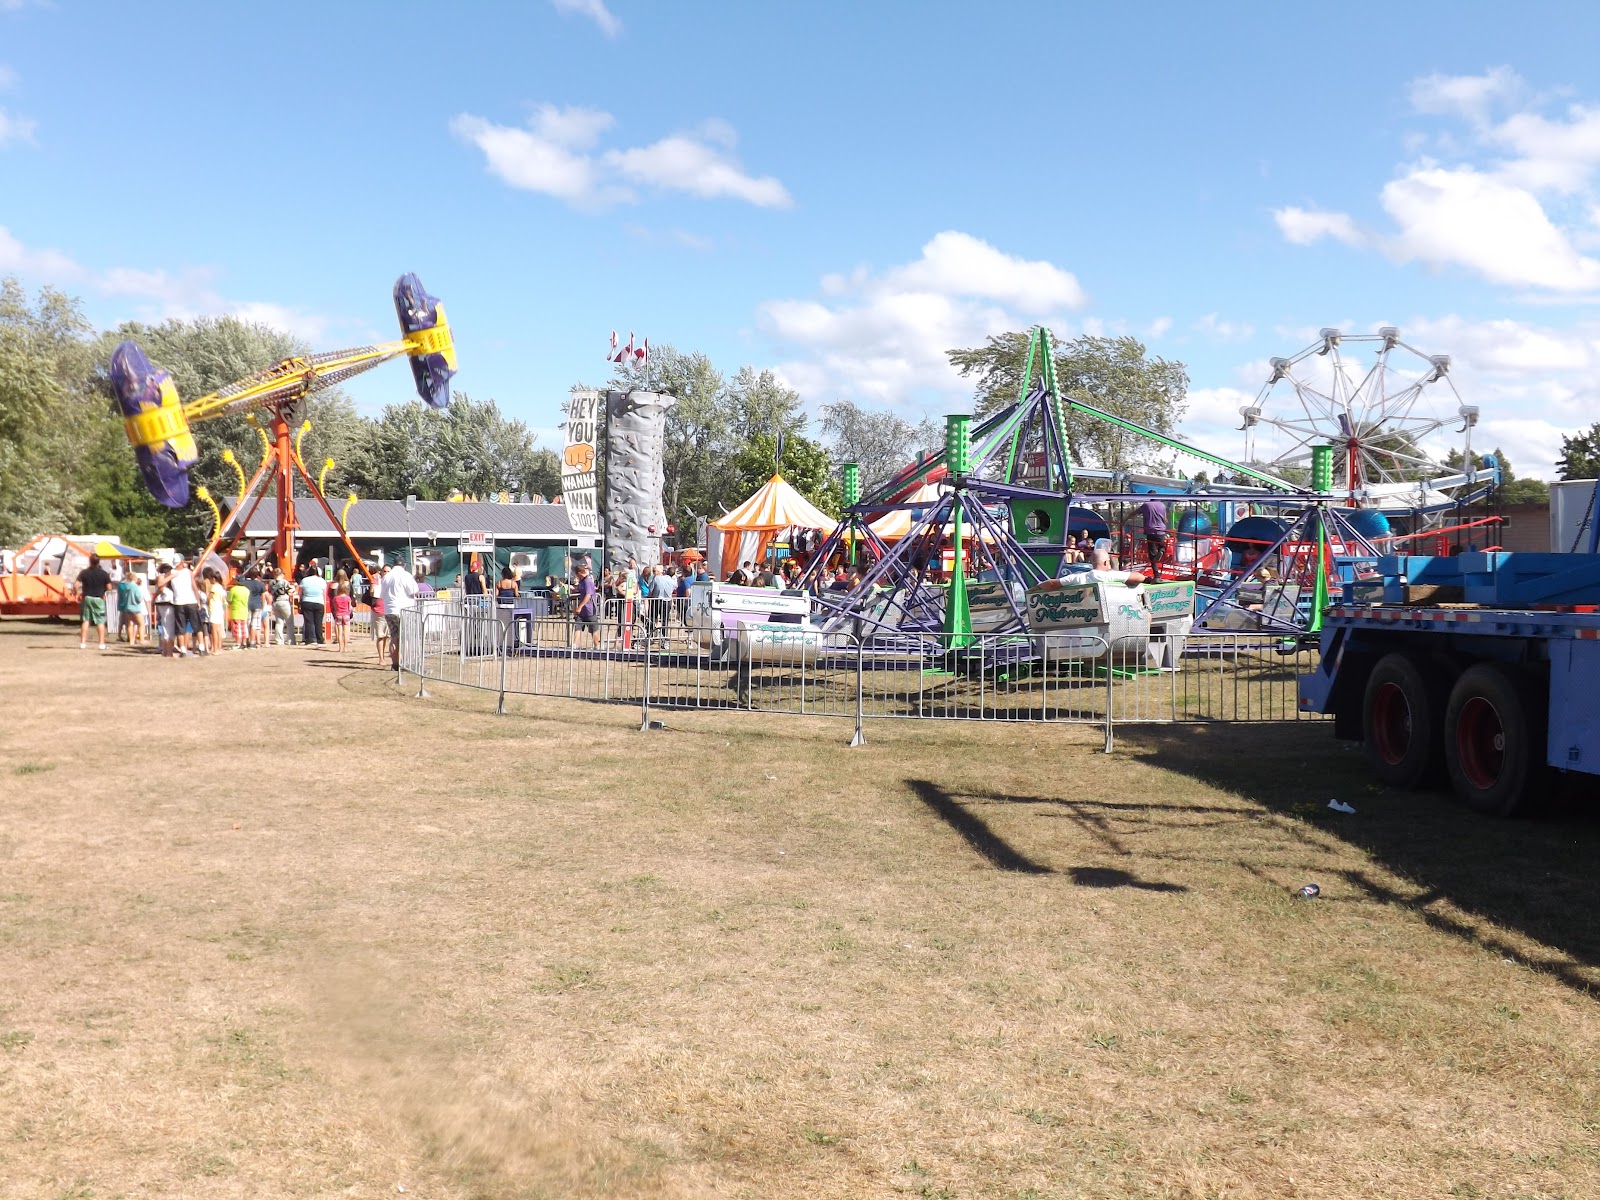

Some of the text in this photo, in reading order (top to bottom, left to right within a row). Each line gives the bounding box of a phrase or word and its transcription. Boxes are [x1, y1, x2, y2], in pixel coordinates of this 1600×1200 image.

[570, 398, 596, 419] HEY
[568, 422, 594, 443] YOU
[562, 473, 596, 491] WANNA
[568, 492, 593, 510] WIN
[570, 513, 597, 528] $100?
[470, 533, 485, 541] EXIT
[1030, 590, 1084, 608] Magical
[1035, 607, 1099, 622] Midways
